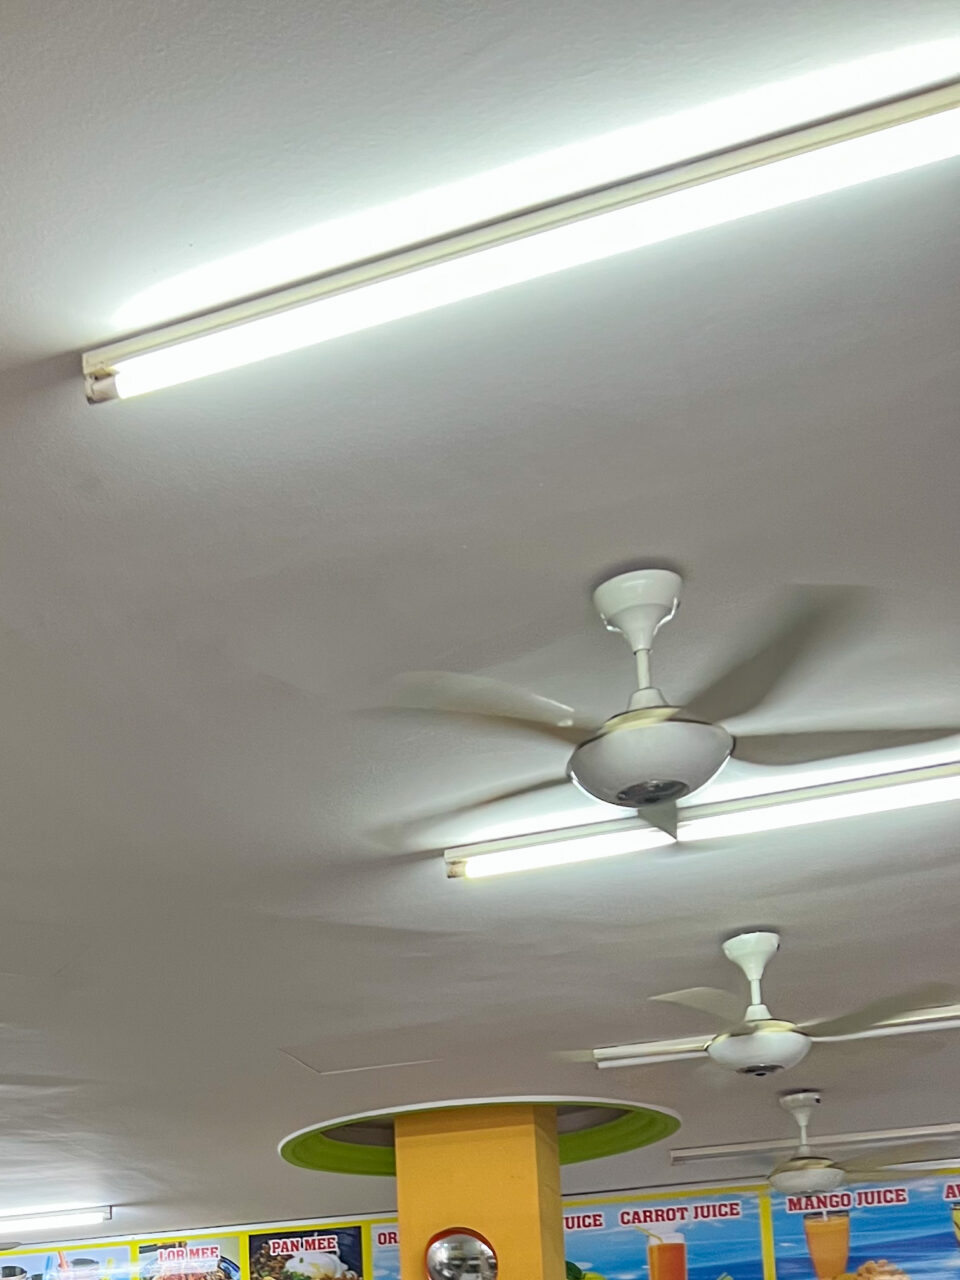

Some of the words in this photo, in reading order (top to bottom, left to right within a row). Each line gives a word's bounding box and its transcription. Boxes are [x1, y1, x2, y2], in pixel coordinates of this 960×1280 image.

[787, 1193, 851, 1212] MANGO
[856, 1188, 907, 1206] JUICE
[563, 1214, 603, 1230] UICE
[620, 1207, 688, 1226] CARROT
[693, 1203, 740, 1220] JUICE
[271, 1240, 299, 1254] PAN
[304, 1237, 336, 1251] MEE
[378, 1231, 399, 1245] OR
[159, 1249, 185, 1262] LOR
[190, 1246, 219, 1260] MEE
